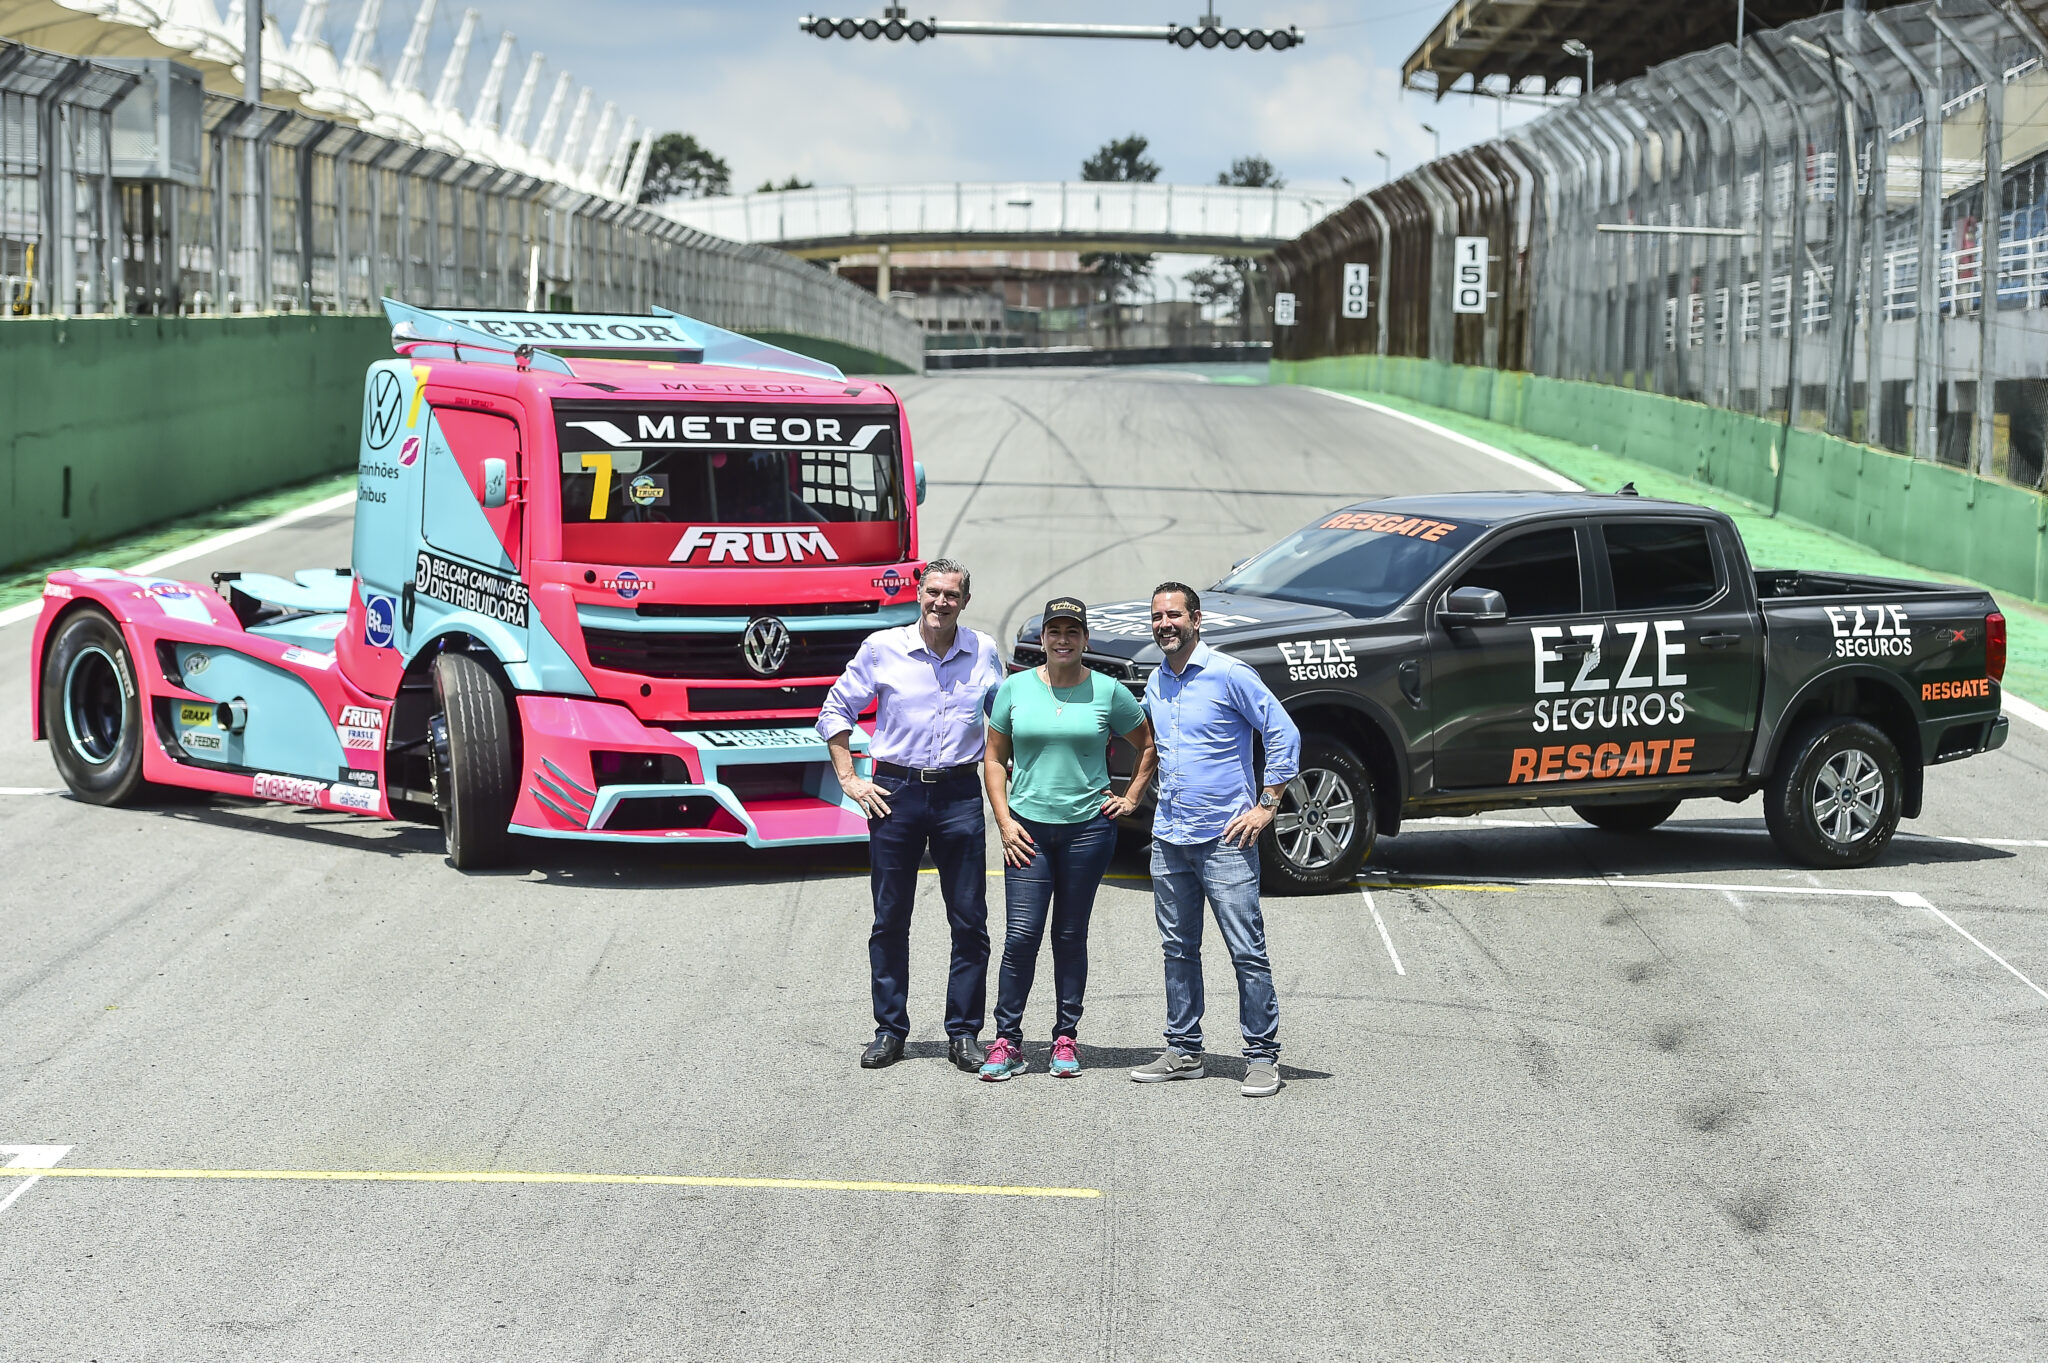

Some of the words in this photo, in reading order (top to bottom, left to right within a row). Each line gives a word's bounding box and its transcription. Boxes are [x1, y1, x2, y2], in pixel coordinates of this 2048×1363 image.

[1460, 243, 1481, 306] 150
[1349, 270, 1362, 313] 100
[454, 319, 685, 342] ERITOR
[661, 382, 809, 393] METEOR
[638, 415, 842, 442] METEOR
[581, 453, 613, 520] 7
[668, 526, 840, 562] FRUM
[1319, 513, 1458, 542] RESGATE
[432, 558, 470, 587] BELCAR
[469, 571, 529, 605] CAMINHÕES
[429, 576, 526, 627] DISTRIBUIDORA
[1823, 604, 1911, 637] EZZE
[1277, 638, 1356, 666] EZZE
[1530, 619, 1687, 694] EZZE
[1835, 637, 1913, 658] SEGUROS
[1288, 663, 1358, 682] SEGUROS
[1921, 678, 1990, 701] RESGATE
[338, 704, 383, 729] FRUM
[1532, 691, 1685, 733] SEGUROS
[1507, 738, 1696, 784] RESGATE
